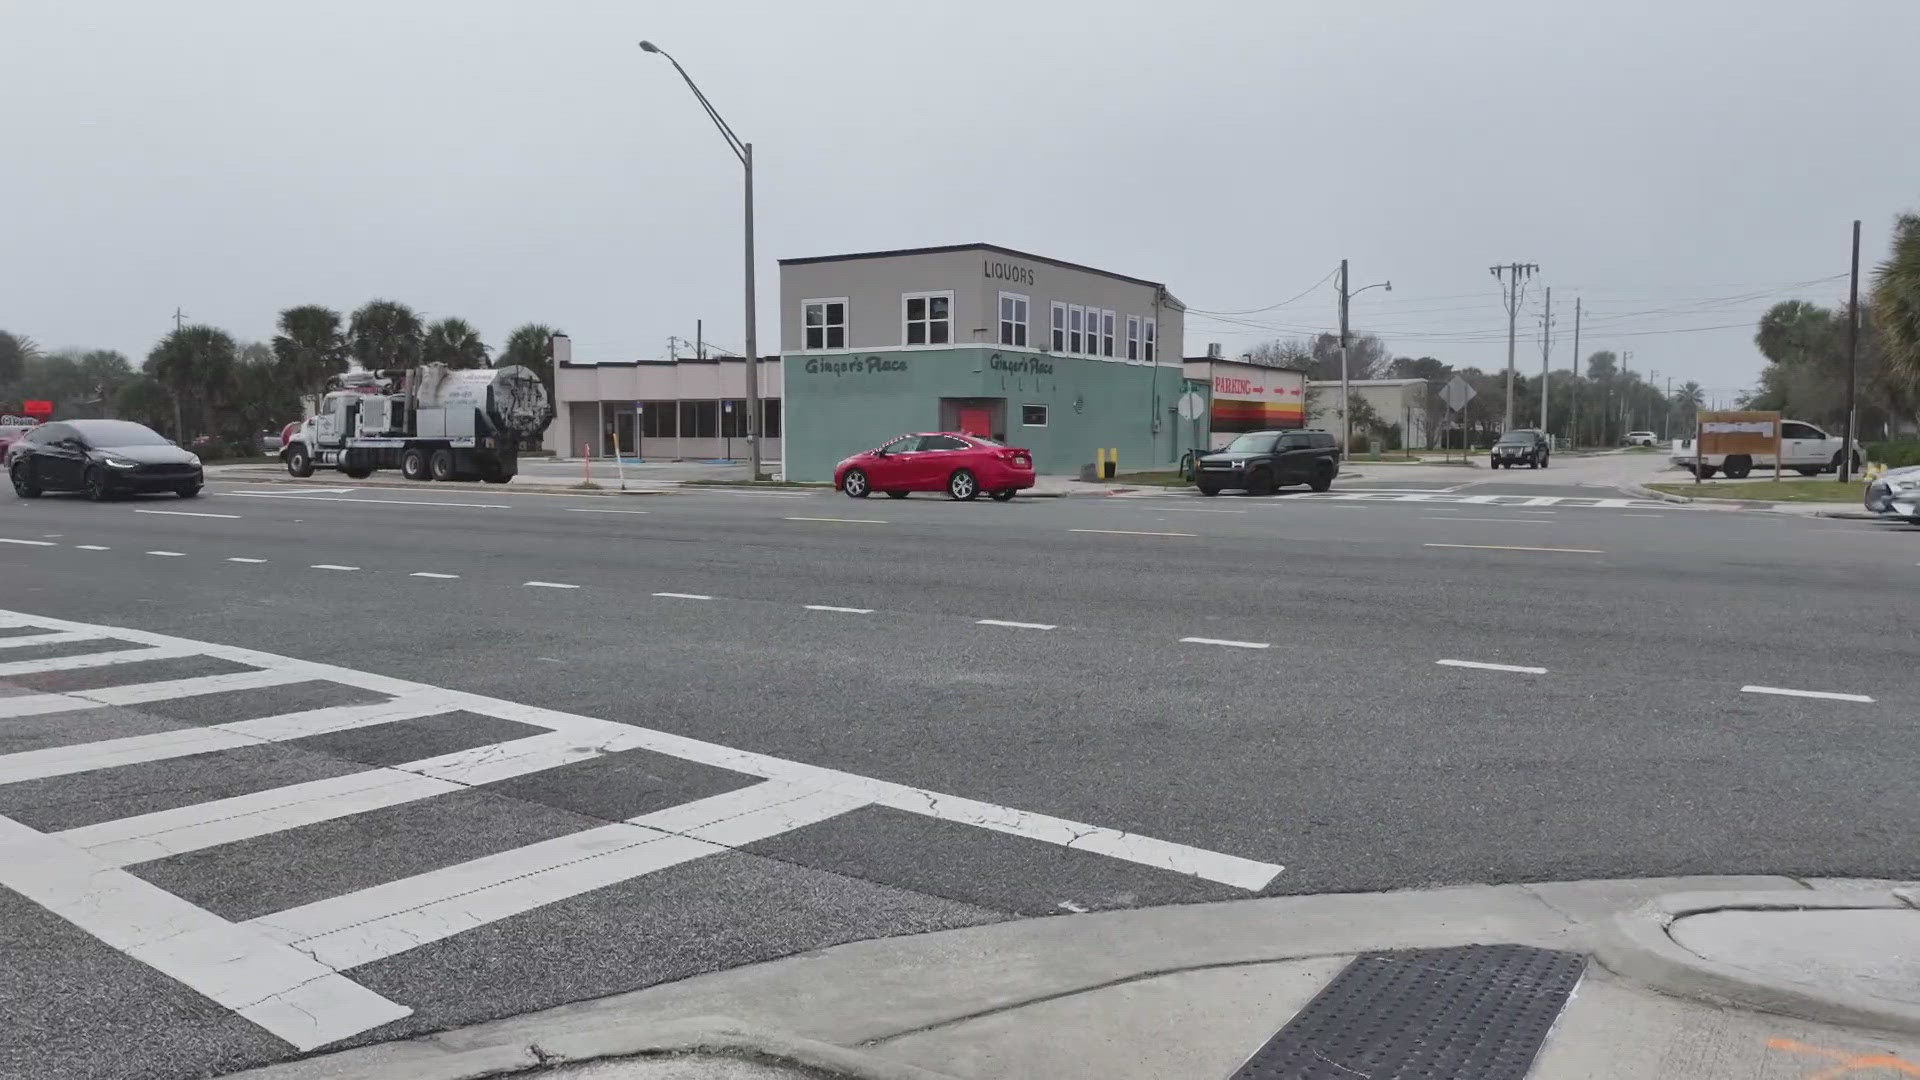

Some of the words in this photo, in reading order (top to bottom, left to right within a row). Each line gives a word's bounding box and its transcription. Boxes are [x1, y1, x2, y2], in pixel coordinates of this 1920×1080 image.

[984, 259, 1034, 286] LIQUORS
[804, 357, 863, 377] Ginger's
[865, 356, 908, 374] Place
[990, 353, 1028, 376] Ginger's
[1028, 357, 1054, 375] Place
[1215, 377, 1251, 395] PARKING
